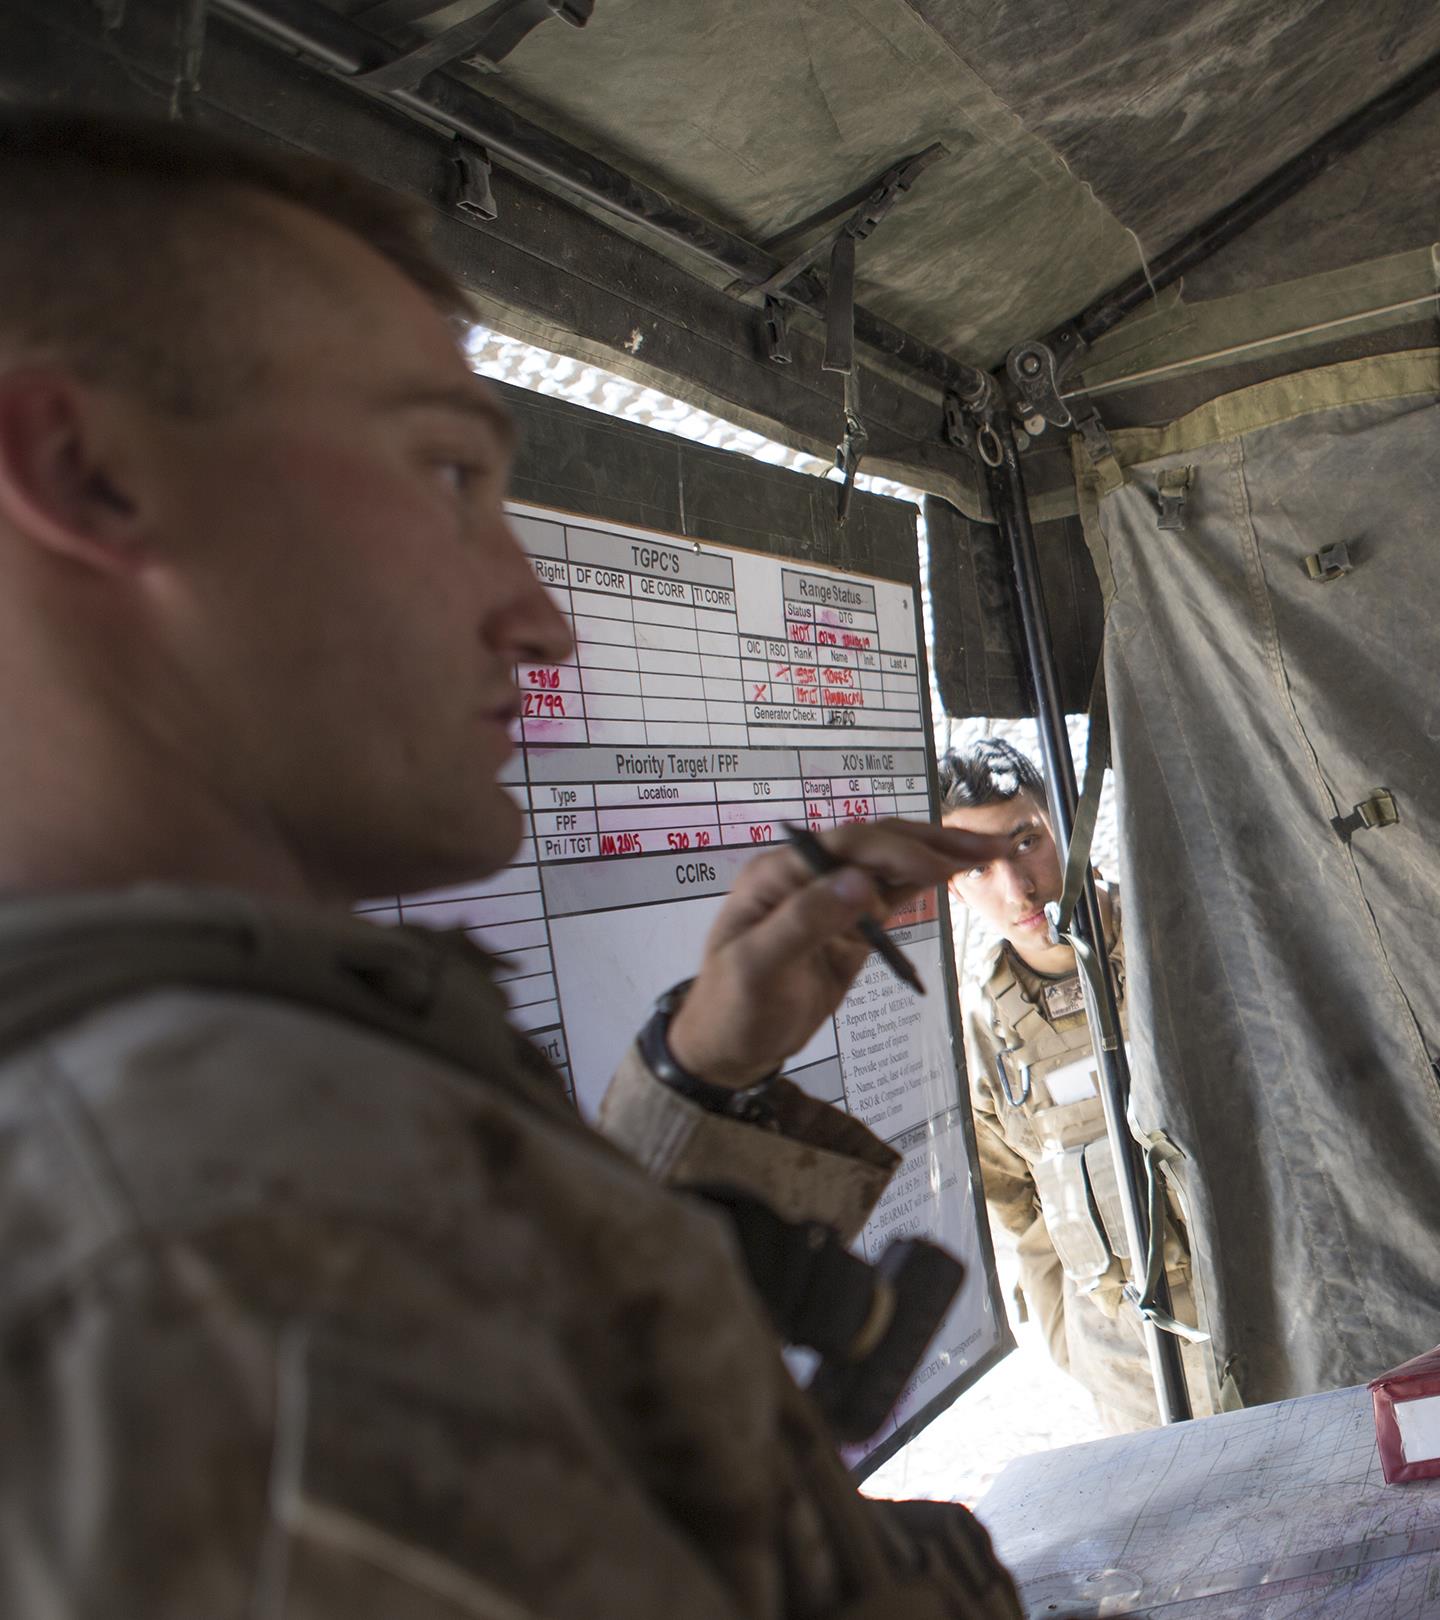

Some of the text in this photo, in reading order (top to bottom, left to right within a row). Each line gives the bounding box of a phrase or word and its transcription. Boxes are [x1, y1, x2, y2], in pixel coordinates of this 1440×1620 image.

[631, 546, 680, 573] TGPC'S
[536, 561, 565, 581] Right
[576, 567, 625, 589] DF CORR
[640, 578, 685, 599] QE CORR
[694, 587, 731, 605] TI CORR
[800, 579, 862, 605] Range Status
[787, 603, 812, 618] Status
[838, 611, 854, 624] DTG
[746, 639, 761, 654] OIC
[769, 643, 787, 657] RSO
[794, 646, 813, 661] Rank
[831, 650, 848, 664] Name
[889, 656, 902, 669] Last
[754, 705, 817, 722] Generator Check:
[616, 753, 664, 779] Priority
[667, 753, 709, 777] Target
[718, 753, 740, 772] FPF
[842, 754, 895, 771] XO's Min QE
[637, 784, 679, 800] Location
[752, 781, 771, 796] DTG
[804, 780, 831, 796] Charge
[848, 779, 860, 792] QE
[873, 778, 895, 793] Charge
[905, 778, 915, 790] QE
[550, 787, 577, 806] Type
[556, 814, 577, 831] FPF
[545, 839, 562, 856] Pri
[569, 837, 592, 854] TGT
[676, 862, 716, 884] CCIRs
[846, 1010, 867, 1028] Report
[868, 1007, 880, 1024] type
[851, 1046, 867, 1060] State
[853, 1060, 878, 1078] Provide
